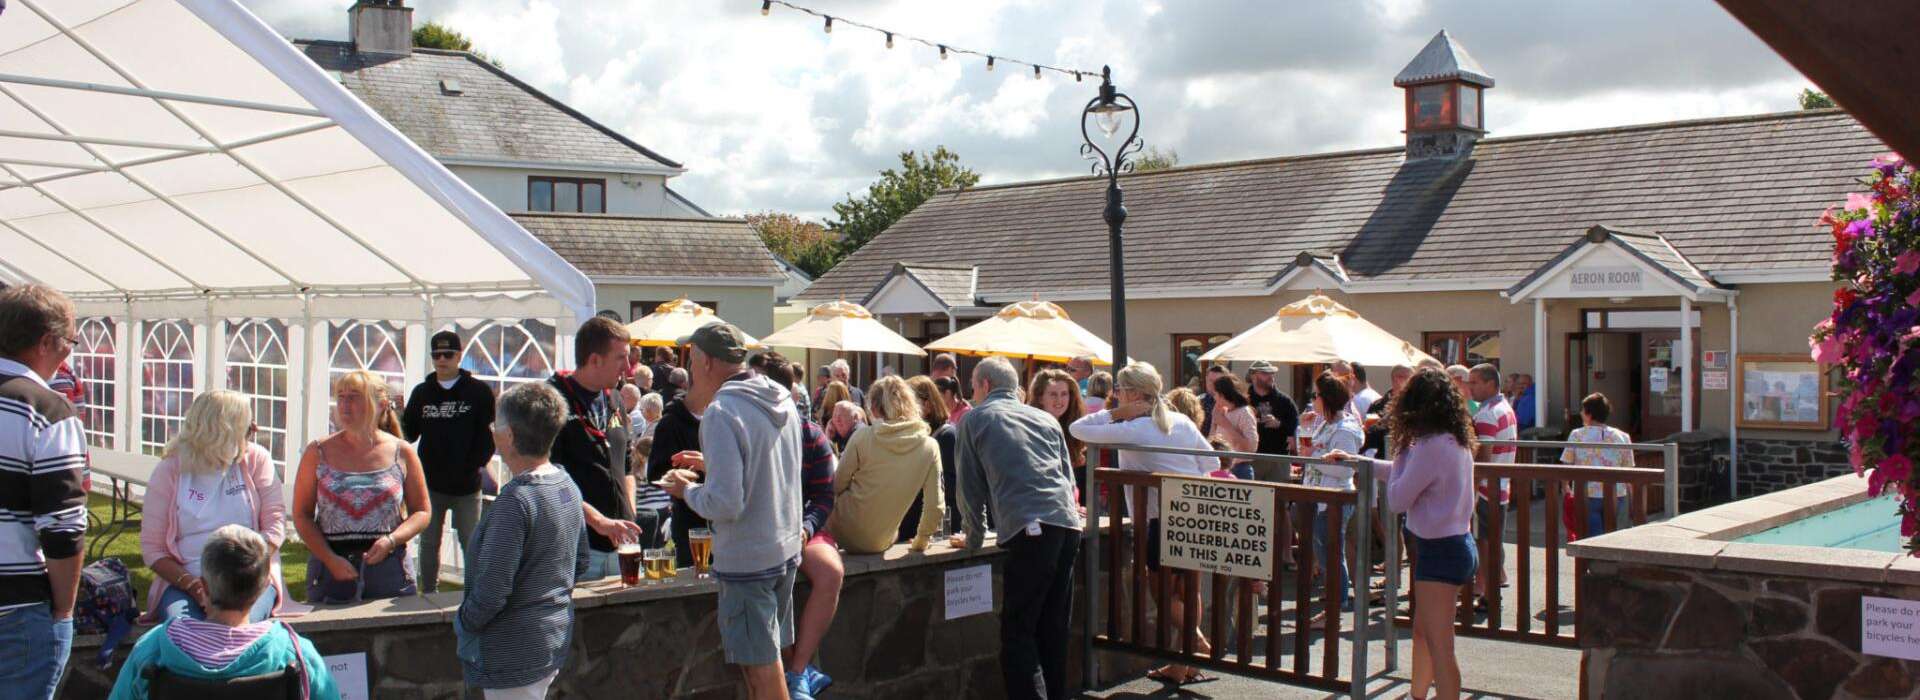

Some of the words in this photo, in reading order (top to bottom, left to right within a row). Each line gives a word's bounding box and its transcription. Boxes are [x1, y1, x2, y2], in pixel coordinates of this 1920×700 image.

[1571, 272, 1605, 284] AERON
[1608, 272, 1640, 284] ROOM
[1182, 483, 1252, 501] STRICTLY
[1170, 500, 1191, 513] NO
[1197, 503, 1265, 523] BICYCLES,
[1168, 515, 1239, 534] SCOOTERS
[1246, 524, 1266, 537] OR
[1167, 530, 1267, 553] ROLLERBLADES
[1169, 545, 1183, 557] IN
[1189, 547, 1217, 561] THIS
[1225, 552, 1262, 567] AREA
[1199, 562, 1217, 570] THANK
[1866, 603, 1898, 615] Please
[1900, 607, 1914, 616] do
[1866, 618, 1889, 628] park
[1890, 621, 1913, 631] your
[1866, 632, 1907, 643] bicycles
[331, 662, 348, 671] not
